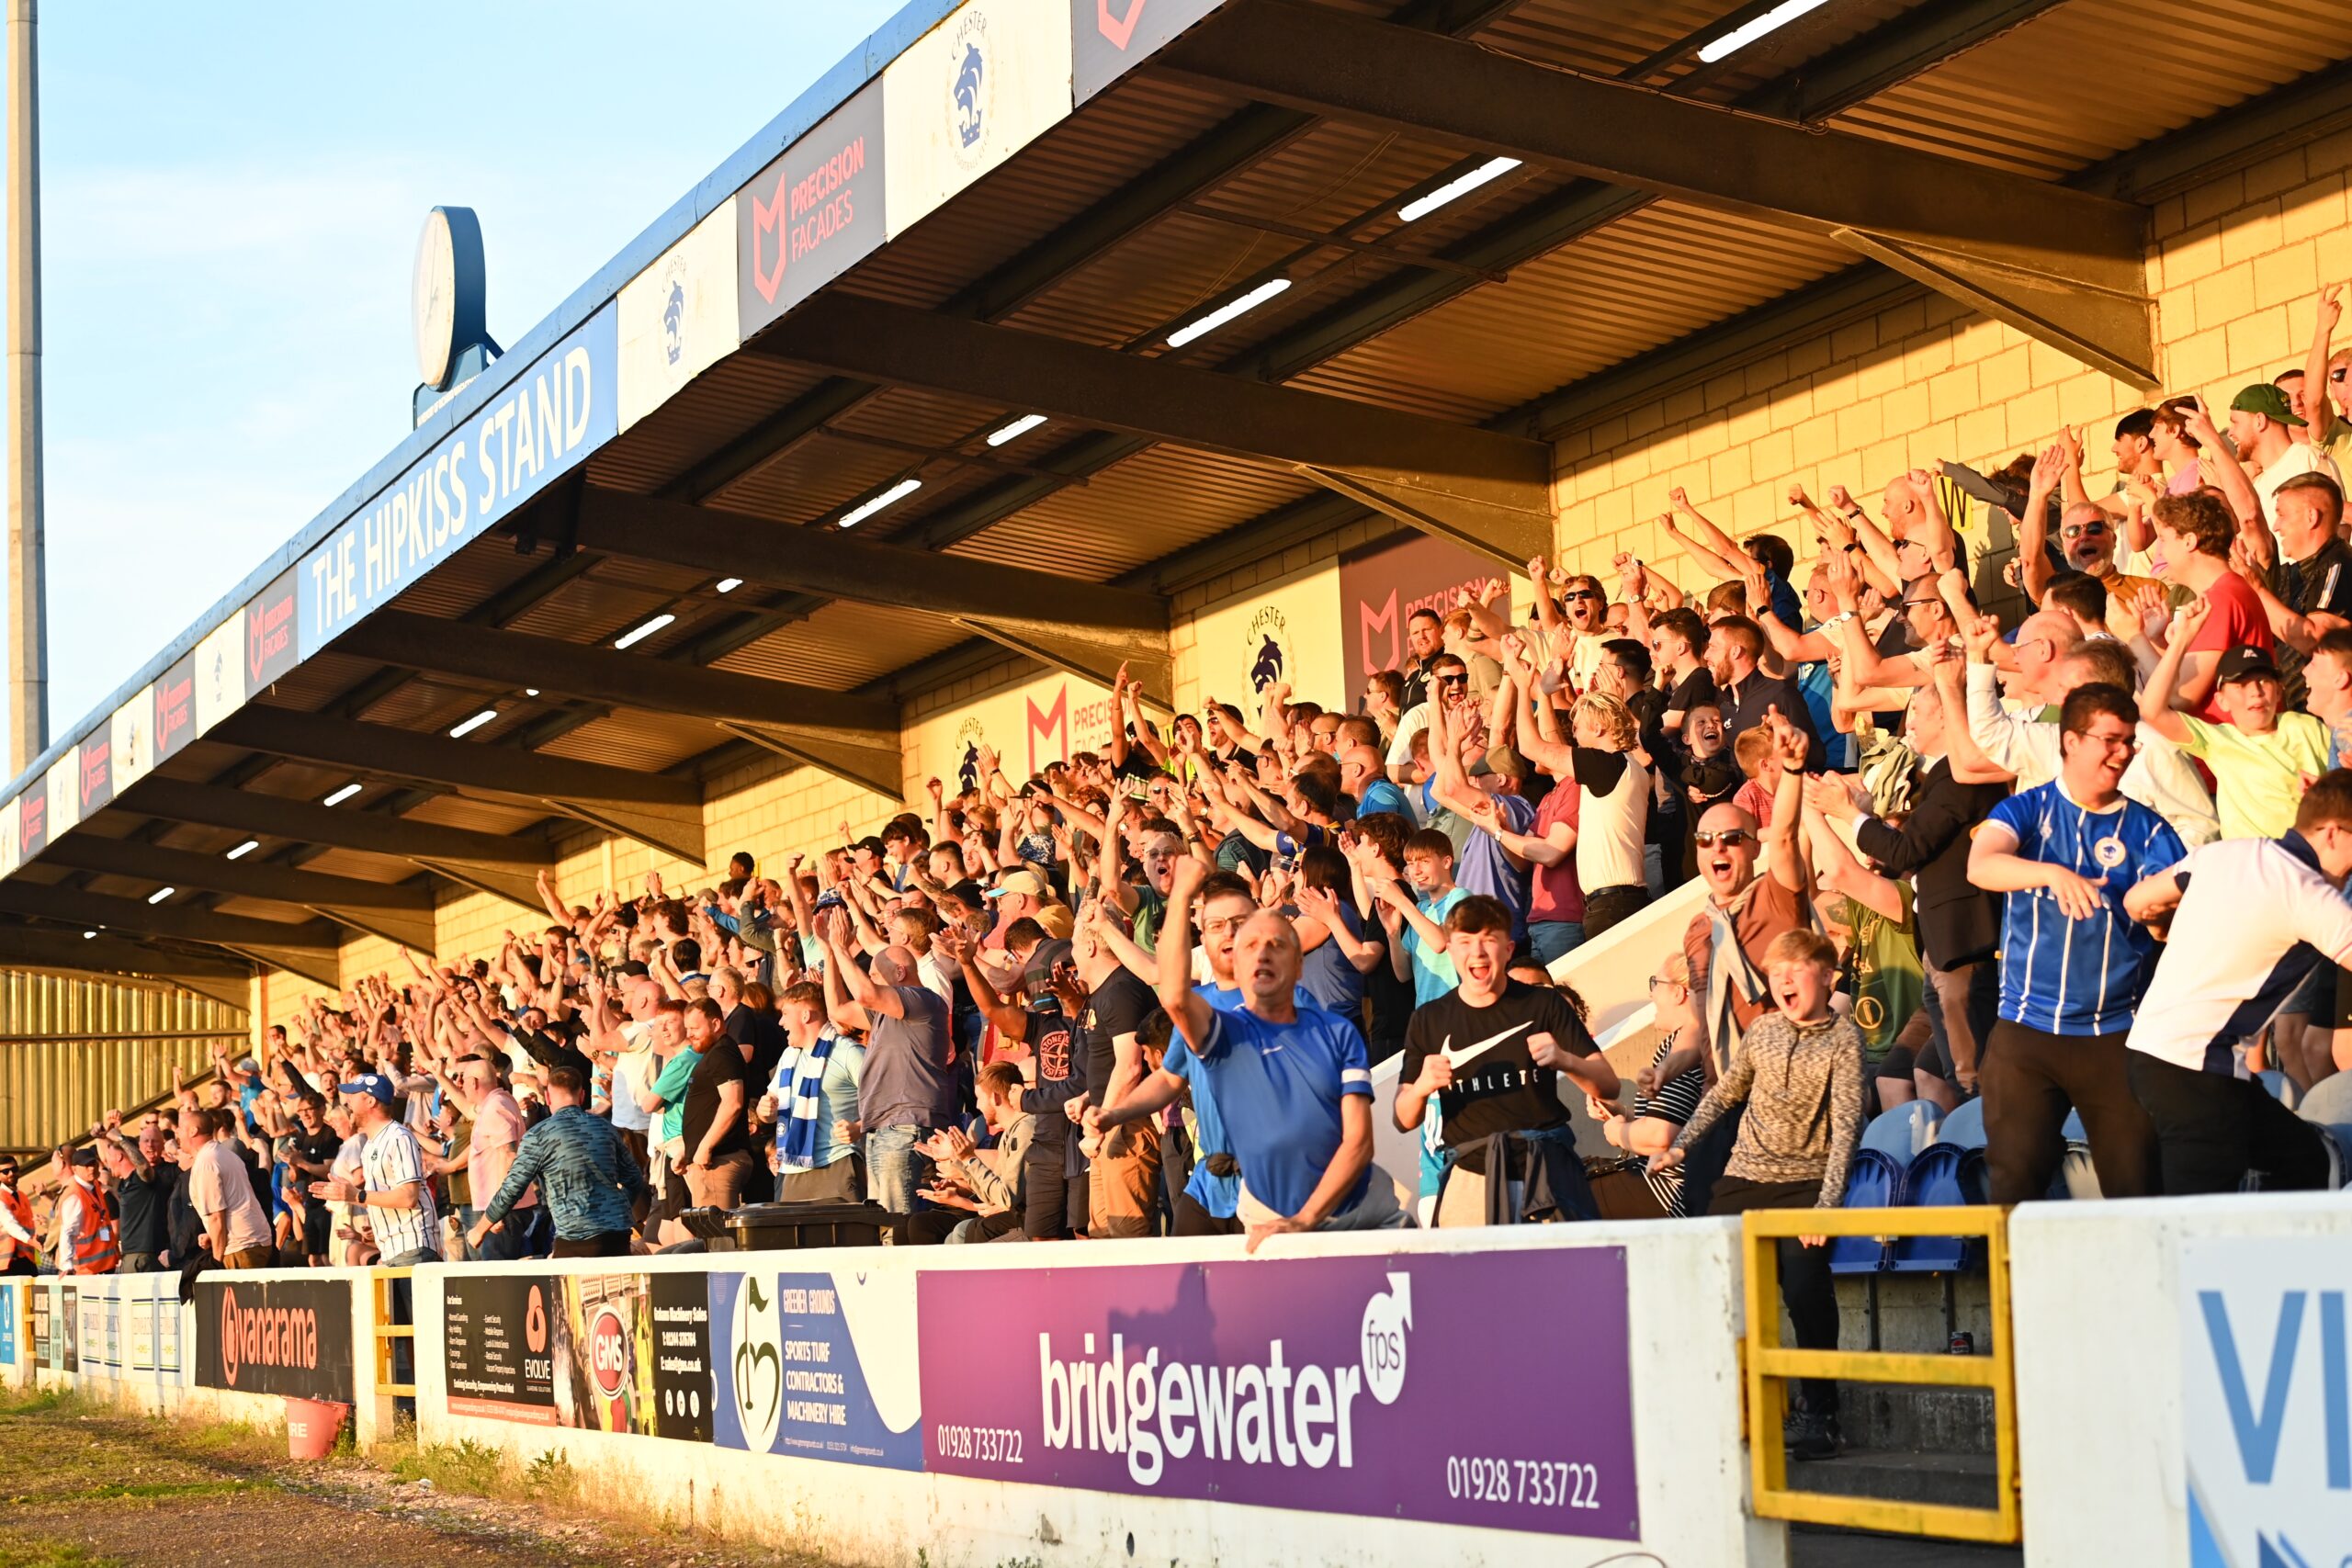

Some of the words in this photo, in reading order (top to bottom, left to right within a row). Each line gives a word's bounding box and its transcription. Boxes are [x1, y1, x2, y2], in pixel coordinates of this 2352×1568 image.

[952, 11, 988, 61] CHESTER
[791, 136, 865, 220] PRECISION
[791, 189, 854, 263] FACADES
[312, 529, 356, 637] THE
[364, 441, 468, 600] HIPKISS
[479, 346, 591, 514] STAND
[1939, 477, 1967, 529] W
[1247, 605, 1286, 646] CHESTER
[956, 716, 984, 750] CHESTER
[1042, 1034, 1063, 1051] STONE
[1448, 1068, 1539, 1093] THLETE
[783, 1289, 808, 1314] GREENER
[808, 1290, 835, 1314] GROUNDS
[237, 1307, 318, 1370] vanarama
[595, 1334, 623, 1372] GMS
[785, 1340, 810, 1362] SPORTS
[811, 1342, 830, 1362] TURF
[1366, 1319, 1401, 1383] fps
[525, 1359, 551, 1380] EVOLVE
[786, 1371, 837, 1393] CONTRACTORS
[837, 1374, 844, 1394] &
[787, 1400, 828, 1424] MACHINERY
[829, 1404, 847, 1426] HIRE
[1039, 1332, 1361, 1485] bridgewater
[937, 1424, 972, 1460] 01928
[972, 1427, 1023, 1463] 733722
[1447, 1455, 1511, 1503] 01928
[1513, 1460, 1600, 1509] 733722
